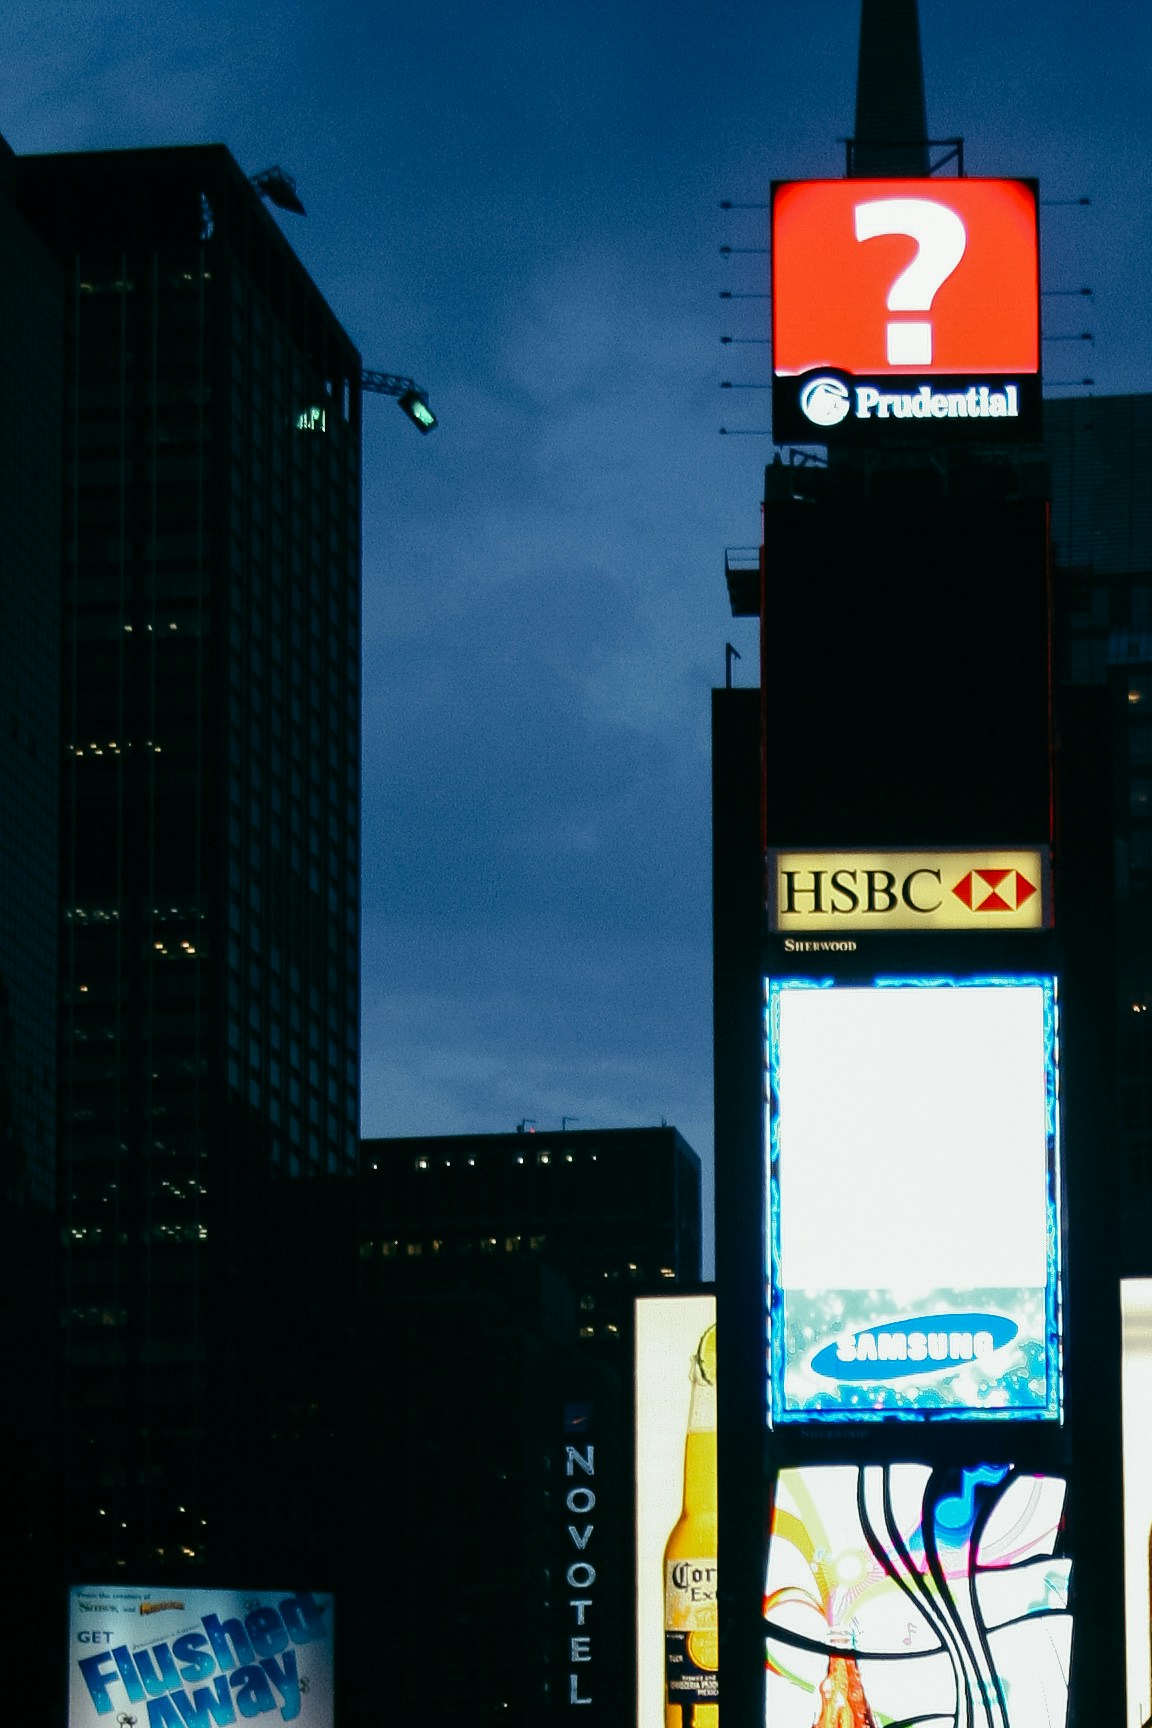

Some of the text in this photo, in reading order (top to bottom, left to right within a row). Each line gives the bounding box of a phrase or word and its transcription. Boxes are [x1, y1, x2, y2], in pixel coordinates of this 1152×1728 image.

[855, 385, 1018, 418] Prudential
[780, 867, 943, 915] HSBC
[836, 1331, 994, 1362] SAMSUNG
[565, 1444, 597, 1706] NOVOTEL
[78, 1631, 113, 1643] GET
[78, 1591, 325, 1716] Flushed
